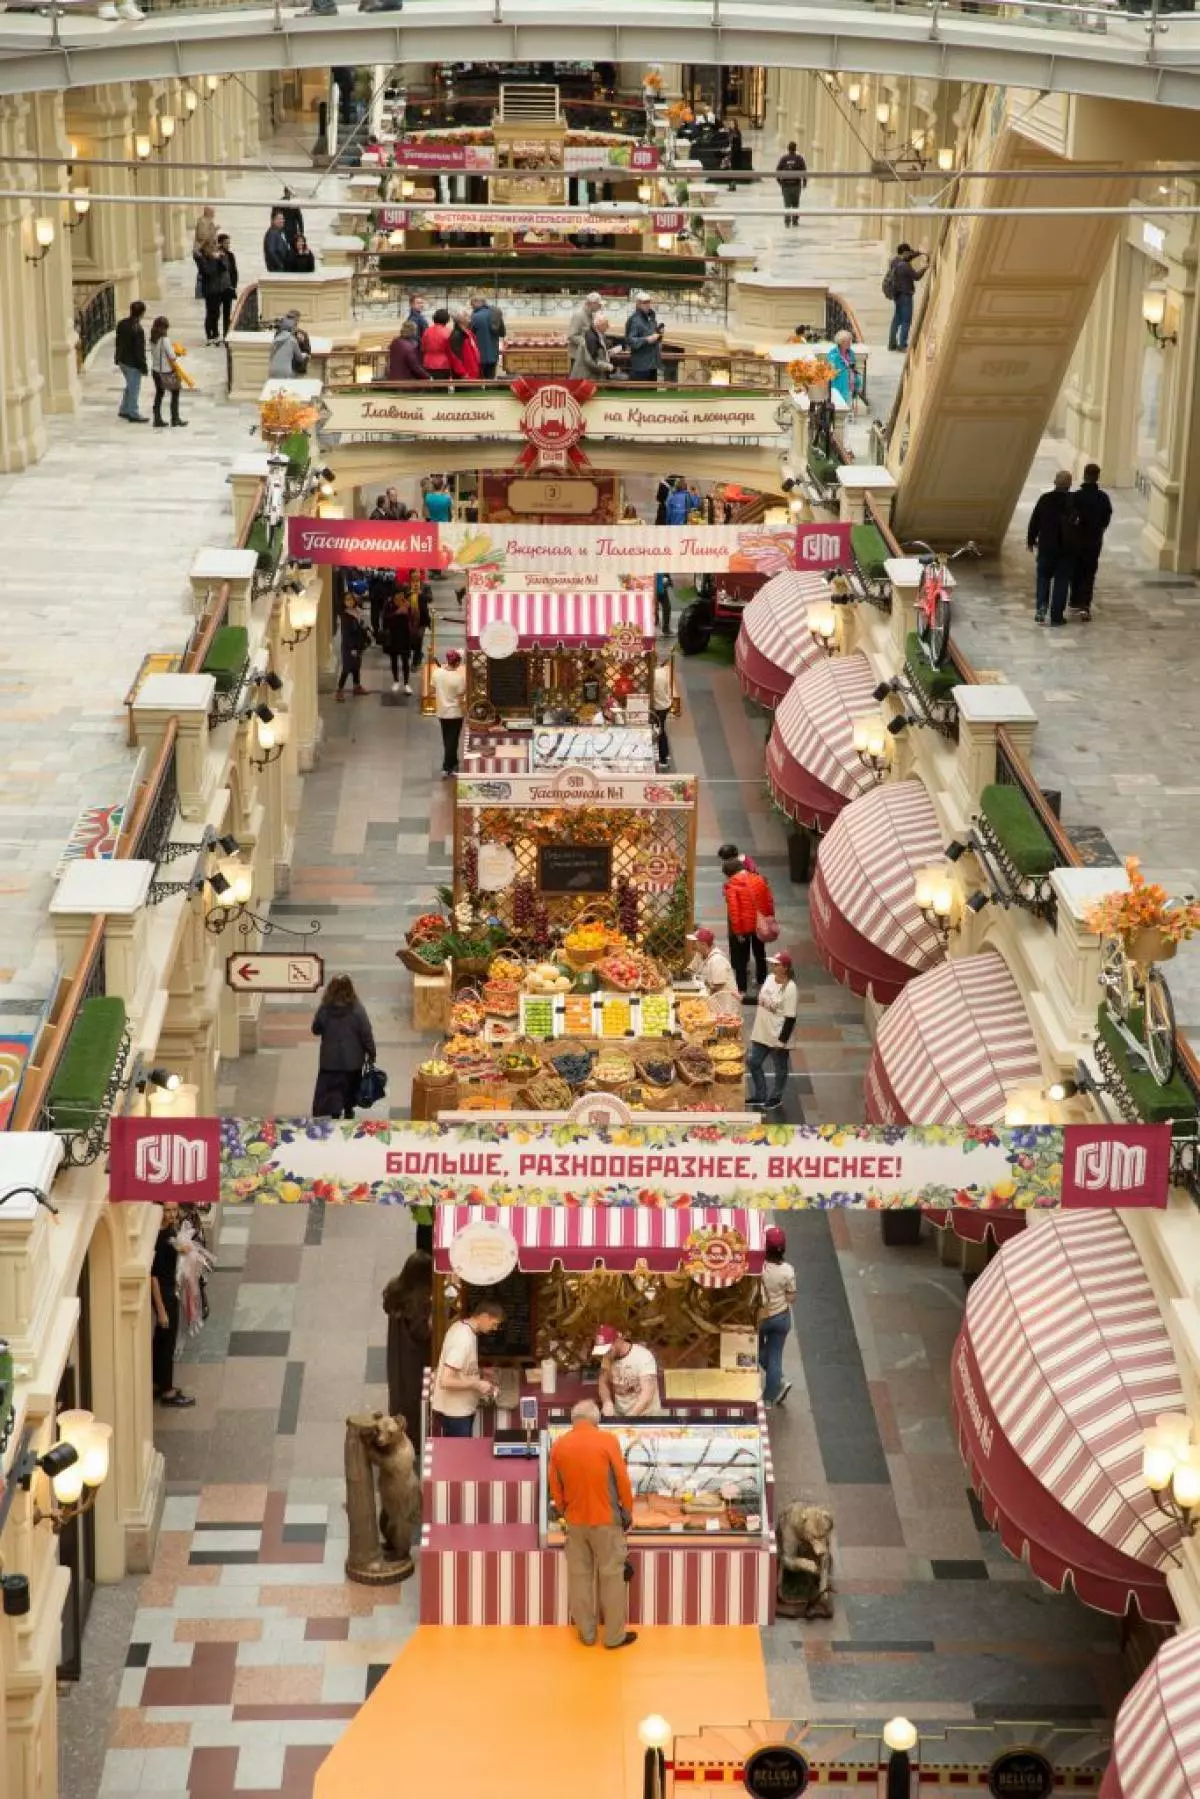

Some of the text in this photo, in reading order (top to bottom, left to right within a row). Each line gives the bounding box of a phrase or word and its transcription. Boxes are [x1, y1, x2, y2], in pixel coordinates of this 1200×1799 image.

[362, 401, 496, 421] Главный магазин
[604, 407, 755, 428] на Красной площади
[302, 532, 433, 553] Гастроном №1
[507, 540, 572, 559] Вкусная
[597, 538, 672, 556] Полезная
[680, 538, 730, 557] Пища
[803, 533, 841, 561] ГУМ
[529, 785, 623, 800] Гастроном №1
[135, 1134, 207, 1184] ГУМ
[386, 1152, 902, 1179] БОЛЬШЕ, РАЗНООБРАЗНЕЕ, ВКУСНЕЕ!
[1074, 1141, 1147, 1190] ГУМ
